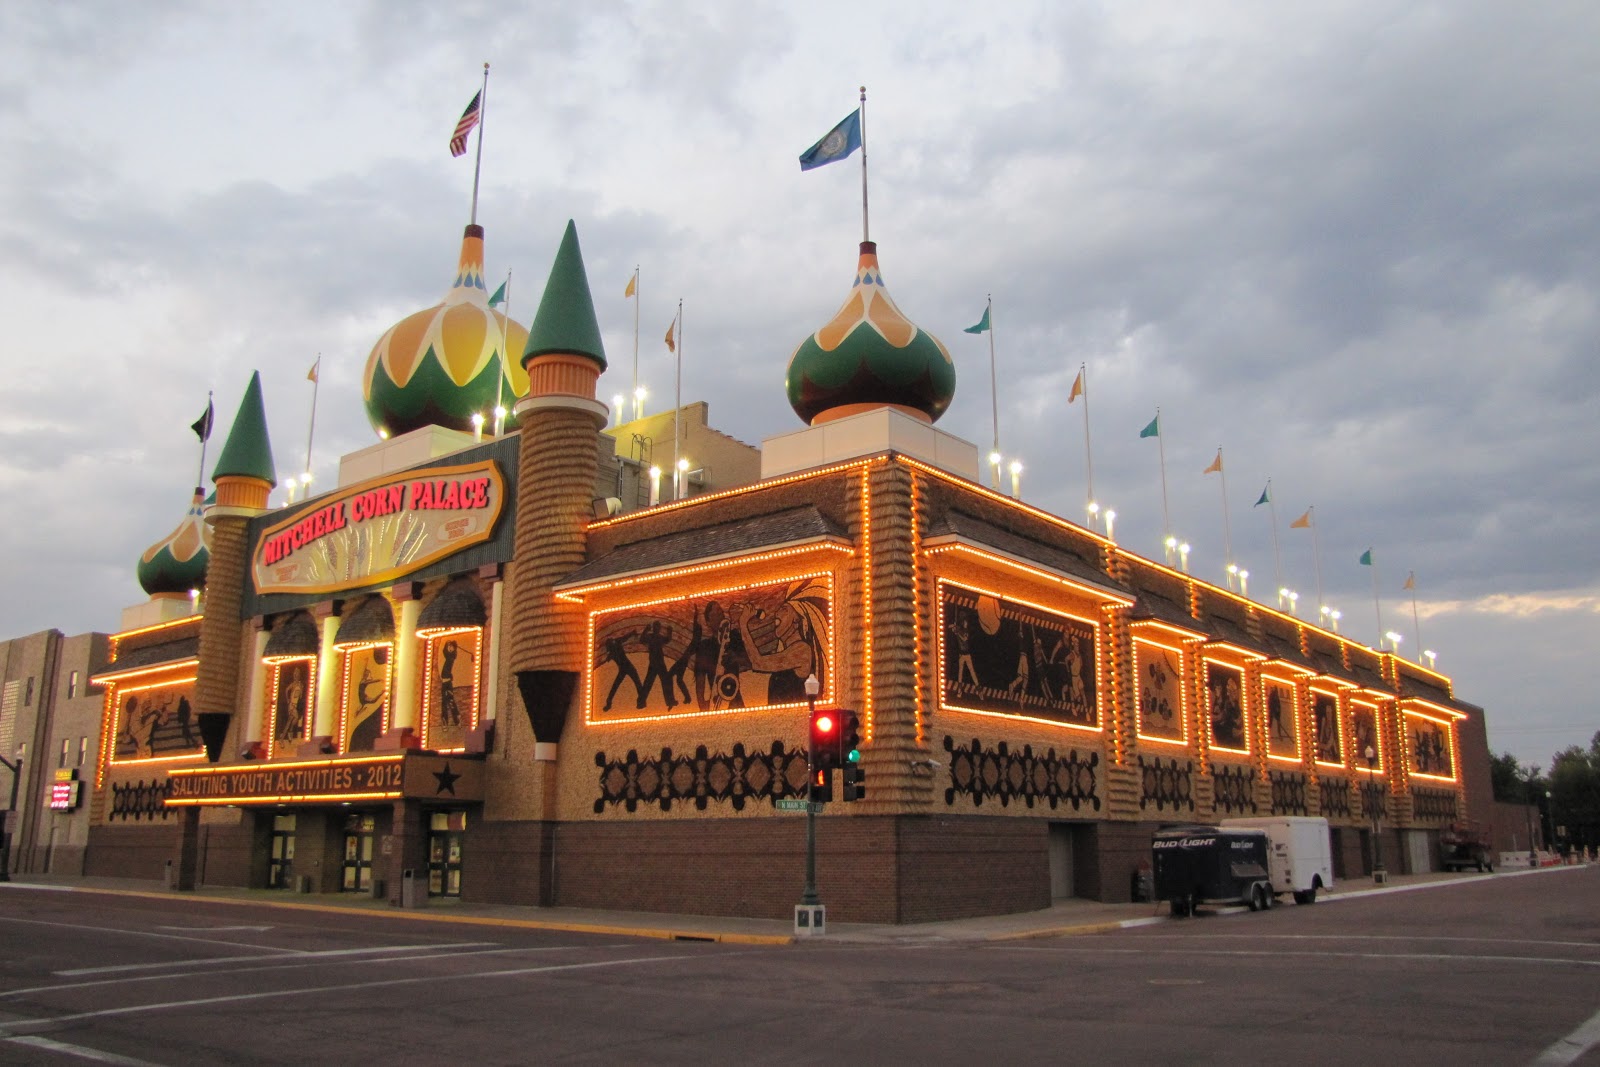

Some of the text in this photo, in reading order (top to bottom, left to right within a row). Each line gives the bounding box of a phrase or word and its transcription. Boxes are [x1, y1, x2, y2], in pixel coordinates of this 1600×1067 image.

[263, 477, 490, 567] MITCHELL CORN PALACE
[172, 764, 402, 796] SALUTING YOUTH ACTIVITIES 2012
[786, 801, 799, 809] MAIN
[800, 801, 806, 809] ST
[1153, 838, 1216, 849] BUD LIGHT
